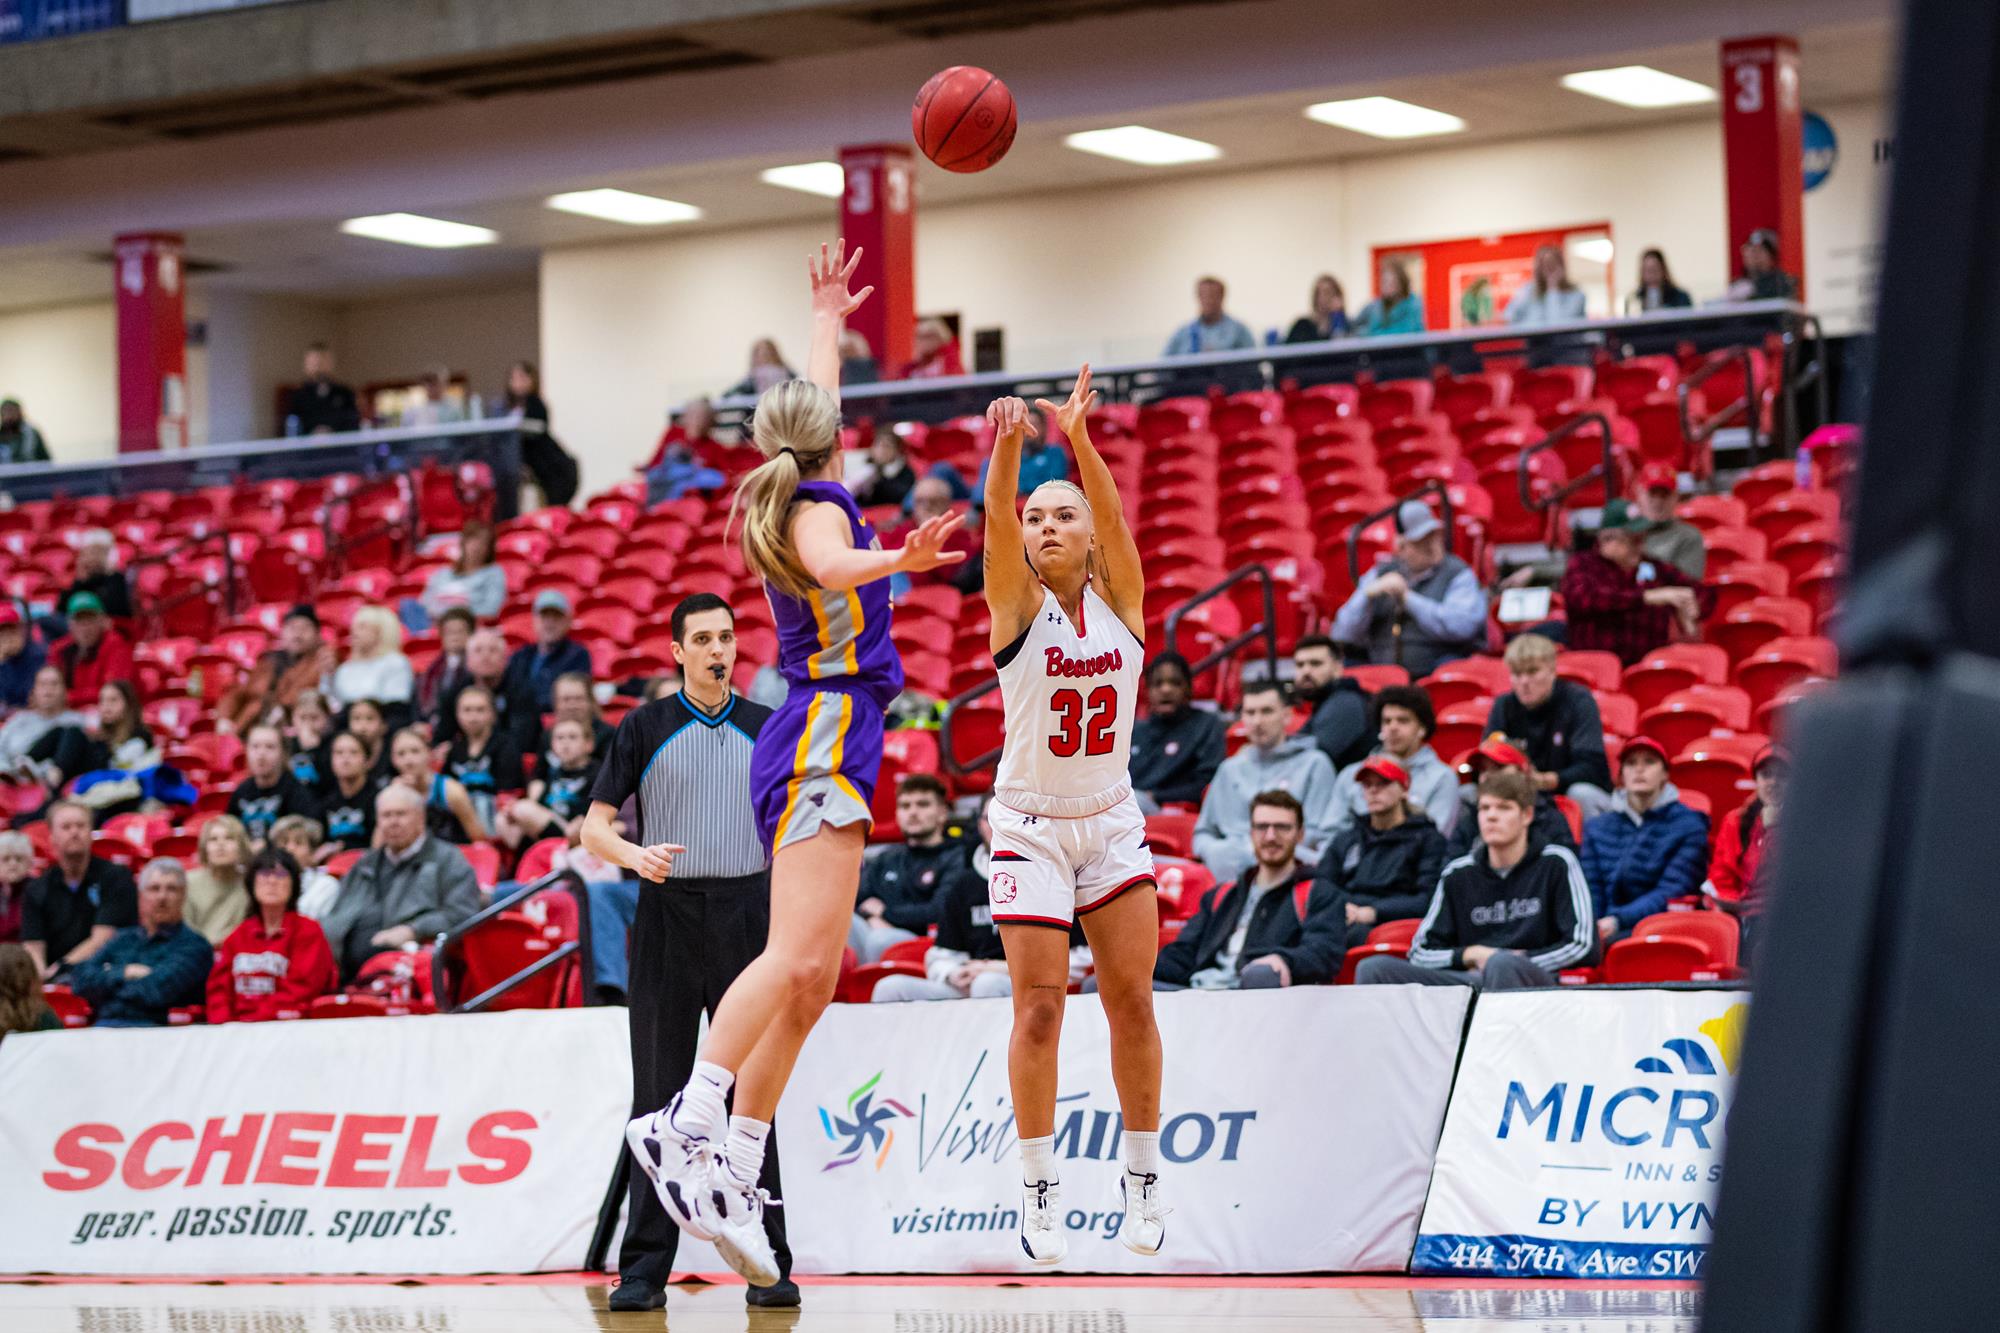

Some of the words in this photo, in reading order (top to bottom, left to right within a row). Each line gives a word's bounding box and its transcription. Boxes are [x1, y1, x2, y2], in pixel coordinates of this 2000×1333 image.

[1735, 64, 1762, 113] 3
[847, 169, 872, 213] 3
[1044, 646, 1123, 678] Beavers
[1048, 684, 1118, 757] 32
[1496, 1080, 1724, 1149] MICR
[42, 1110, 539, 1191] SCHEELS
[1624, 1162, 1674, 1181] INN
[1681, 1164, 1697, 1182] &
[71, 1208, 157, 1244] gear.
[167, 1200, 314, 1240] passion.
[328, 1202, 457, 1244] sports.
[893, 1203, 1125, 1240] visitminorg
[1538, 1198, 1600, 1227] BY
[1622, 1201, 1715, 1231] WYN
[1449, 1243, 1494, 1269] 414
[1506, 1244, 1565, 1272] 37th
[1579, 1248, 1639, 1276] Ave
[1649, 1249, 1707, 1276] SW
